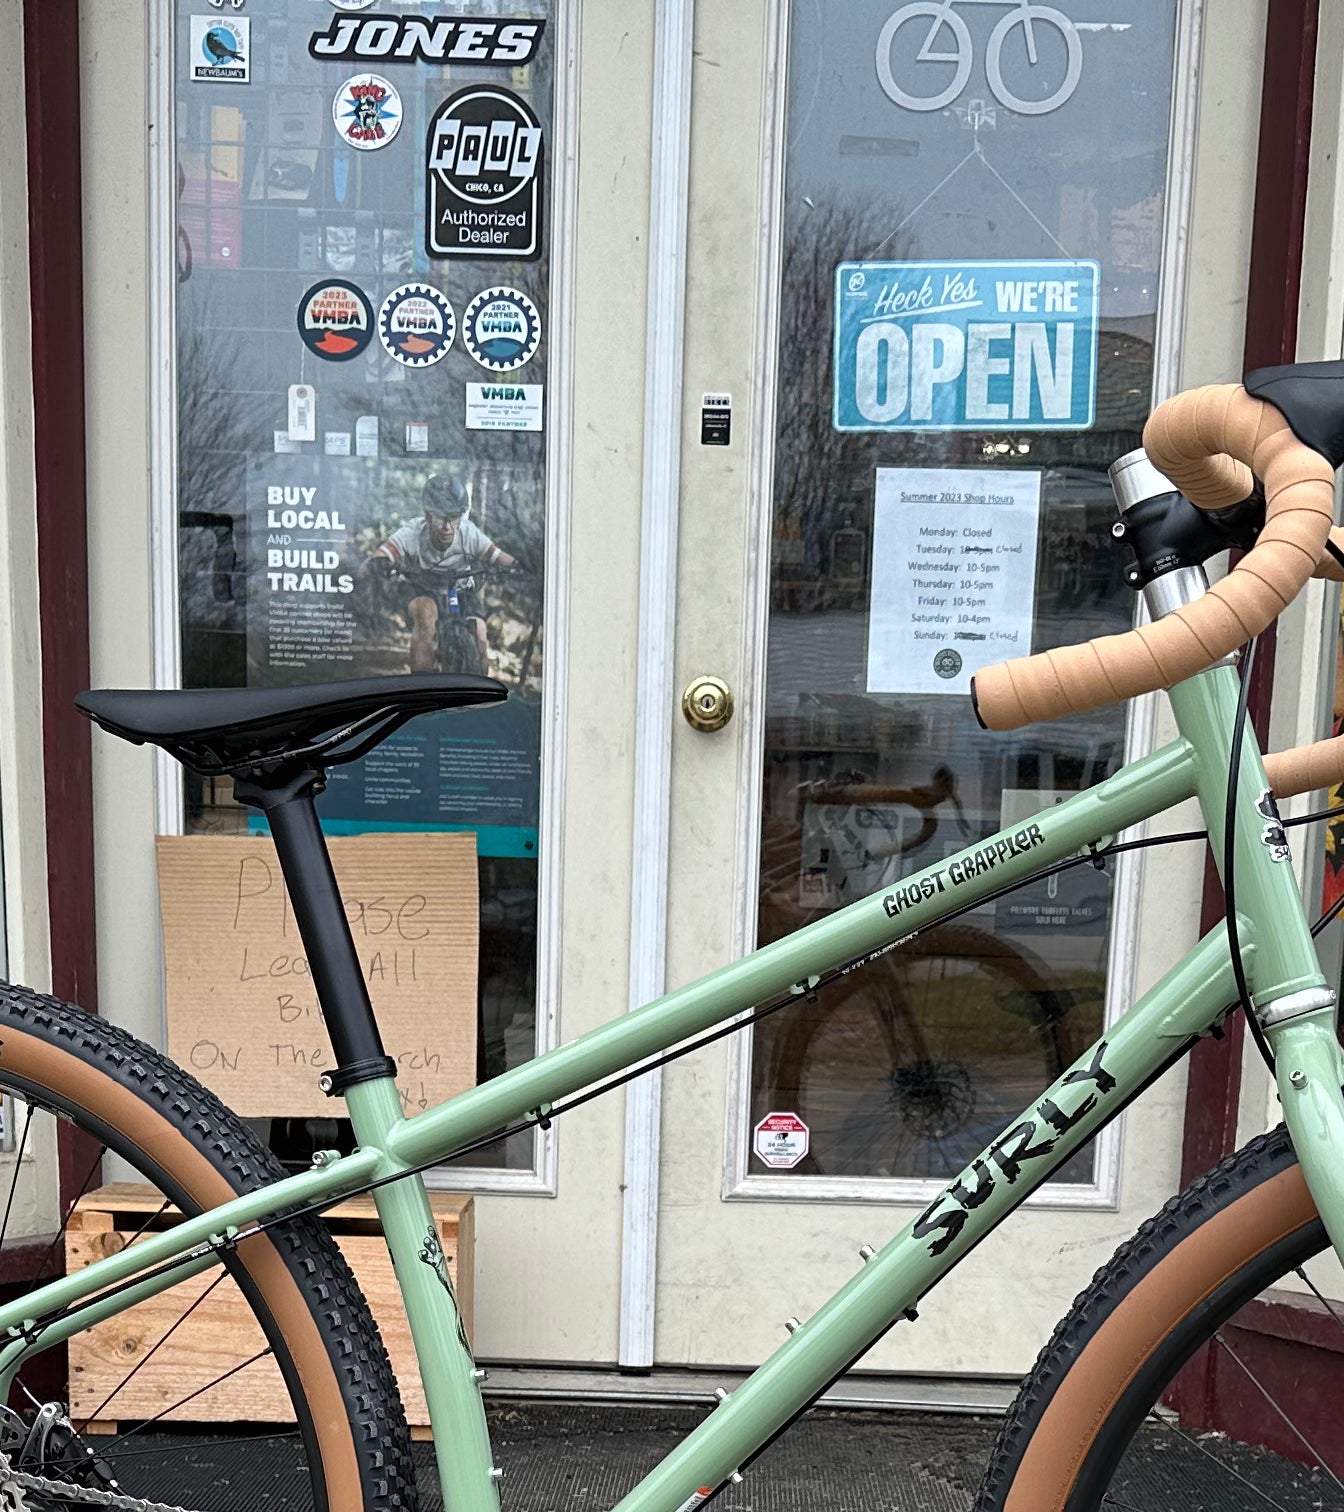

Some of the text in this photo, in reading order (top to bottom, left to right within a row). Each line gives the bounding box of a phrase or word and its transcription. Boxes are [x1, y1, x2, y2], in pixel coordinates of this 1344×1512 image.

[314, 19, 539, 60] JONES
[433, 126, 536, 170] PAUL
[441, 209, 527, 228] Authorized
[458, 227, 510, 245] Dealer
[322, 291, 348, 300] 2023
[873, 271, 1079, 316] Heck Yes WE'RE
[313, 301, 357, 310] PARTNER
[407, 300, 428, 308] 2022
[491, 304, 511, 312] 2021
[310, 310, 362, 326] VMBA
[399, 307, 435, 316] PARTNER
[483, 311, 519, 319] PARTNER
[396, 316, 438, 330] VMBA
[481, 320, 523, 333] VMBA
[855, 321, 1075, 424] OPEN
[480, 386, 527, 401] VMBA
[267, 486, 317, 506] BUY
[900, 491, 1015, 504] Summer 2023 Shop Hours
[267, 509, 346, 531] LOCAL
[919, 527, 993, 538] Monday: Closed
[267, 535, 293, 545] AND
[916, 545, 956, 555] Tuesday:
[267, 549, 340, 570] BUILD
[908, 561, 1000, 573] Wednesday: 10-5pm
[267, 572, 354, 594] TRAILS
[912, 579, 994, 591] Thursday: 10-5pm
[918, 596, 986, 608] Friday: 10-5pm
[911, 613, 992, 624] Saturday: 10-4pm
[913, 630, 950, 641] Sunday:
[881, 822, 1046, 919] GHOST GRAPPLER
[233, 856, 430, 941] Plase
[369, 948, 418, 986] All
[269, 1043, 328, 1068] The
[912, 1039, 1118, 1259] SURLY
